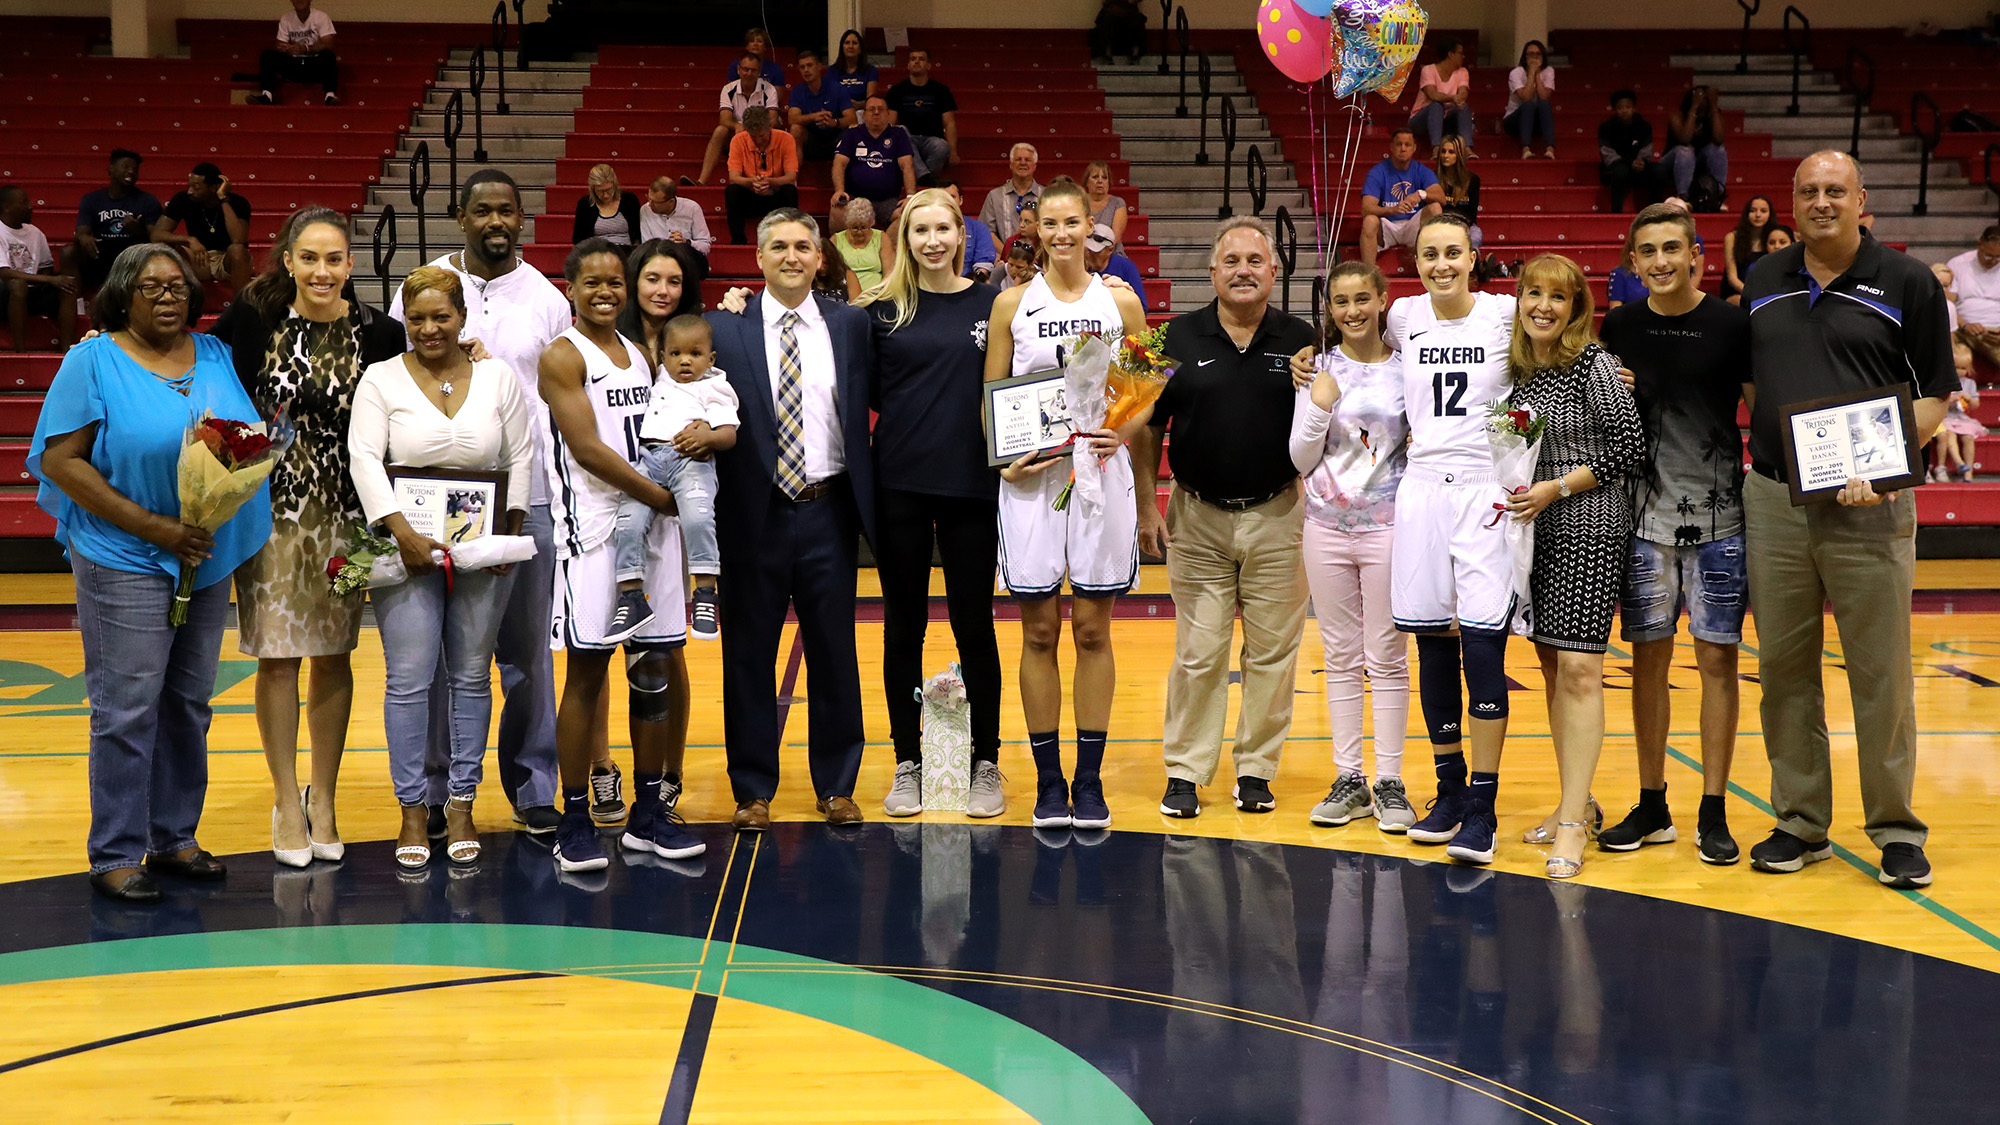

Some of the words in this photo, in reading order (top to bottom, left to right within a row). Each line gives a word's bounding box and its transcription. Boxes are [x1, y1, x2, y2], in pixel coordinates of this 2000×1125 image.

[1856, 284, 1885, 296] AND1
[1038, 319, 1102, 338] ECKERD
[1682, 330, 1703, 338] PLACE
[1419, 347, 1485, 364] ECKERD
[1004, 393, 1029, 403] TRITONS
[1432, 372, 1468, 417] 12
[1804, 418, 1836, 429] TRITONS
[1006, 437, 1031, 445] WOMEN'S
[1003, 442, 1035, 451] BASKETBALL
[1809, 443, 1838, 453] YARDEN
[1811, 452, 1837, 461] DANAN
[1812, 470, 1842, 478] WOMEN'S
[1808, 474, 1848, 485] BASKETBALL
[406, 487, 436, 496] TRITONS
